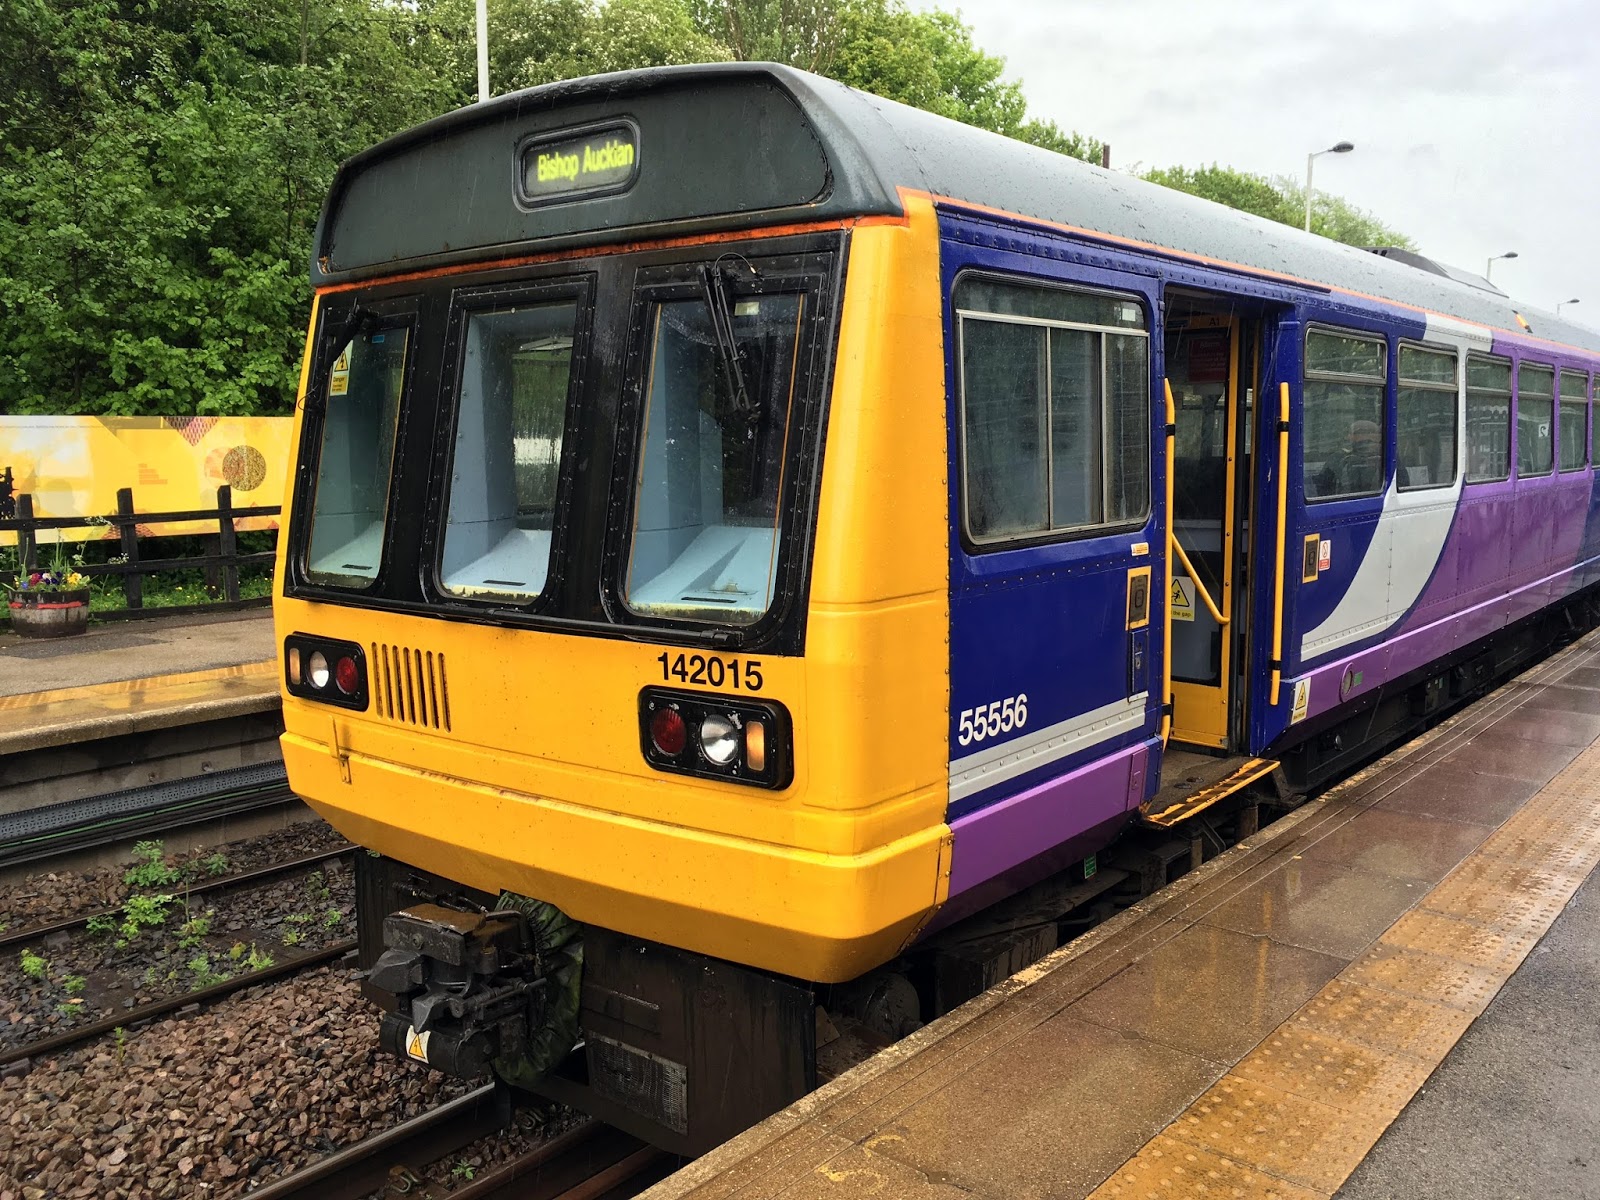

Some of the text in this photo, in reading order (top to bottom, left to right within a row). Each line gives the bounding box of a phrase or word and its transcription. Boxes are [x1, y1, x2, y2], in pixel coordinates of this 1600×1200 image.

[538, 140, 634, 181] Bishop Aucklan
[658, 652, 763, 691] 142015
[958, 693, 1028, 746] 55556
